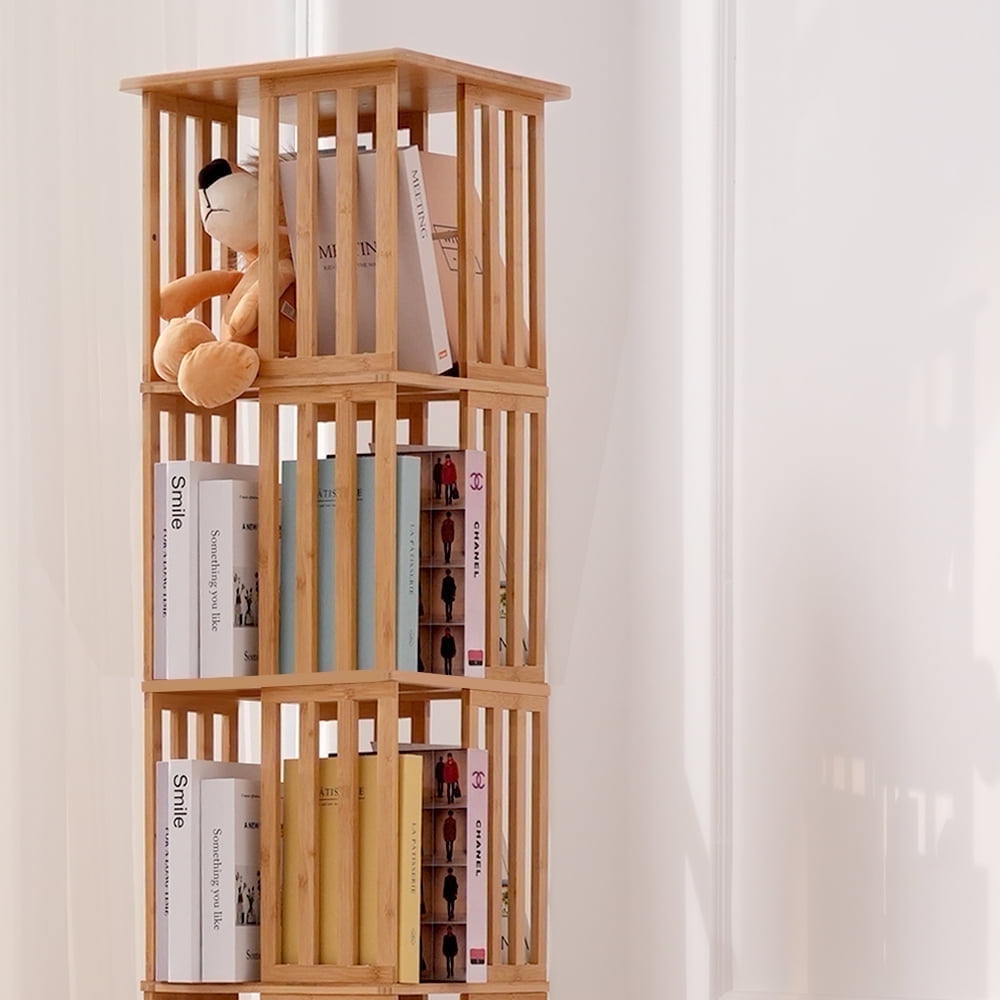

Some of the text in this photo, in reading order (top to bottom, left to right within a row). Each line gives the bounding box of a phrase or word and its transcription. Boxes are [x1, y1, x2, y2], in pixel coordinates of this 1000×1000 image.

[411, 169, 428, 239] MEETING
[171, 475, 186, 530] Smile
[208, 529, 221, 632] Something you like
[173, 774, 188, 829] Smile
[210, 828, 223, 931] Something you like
